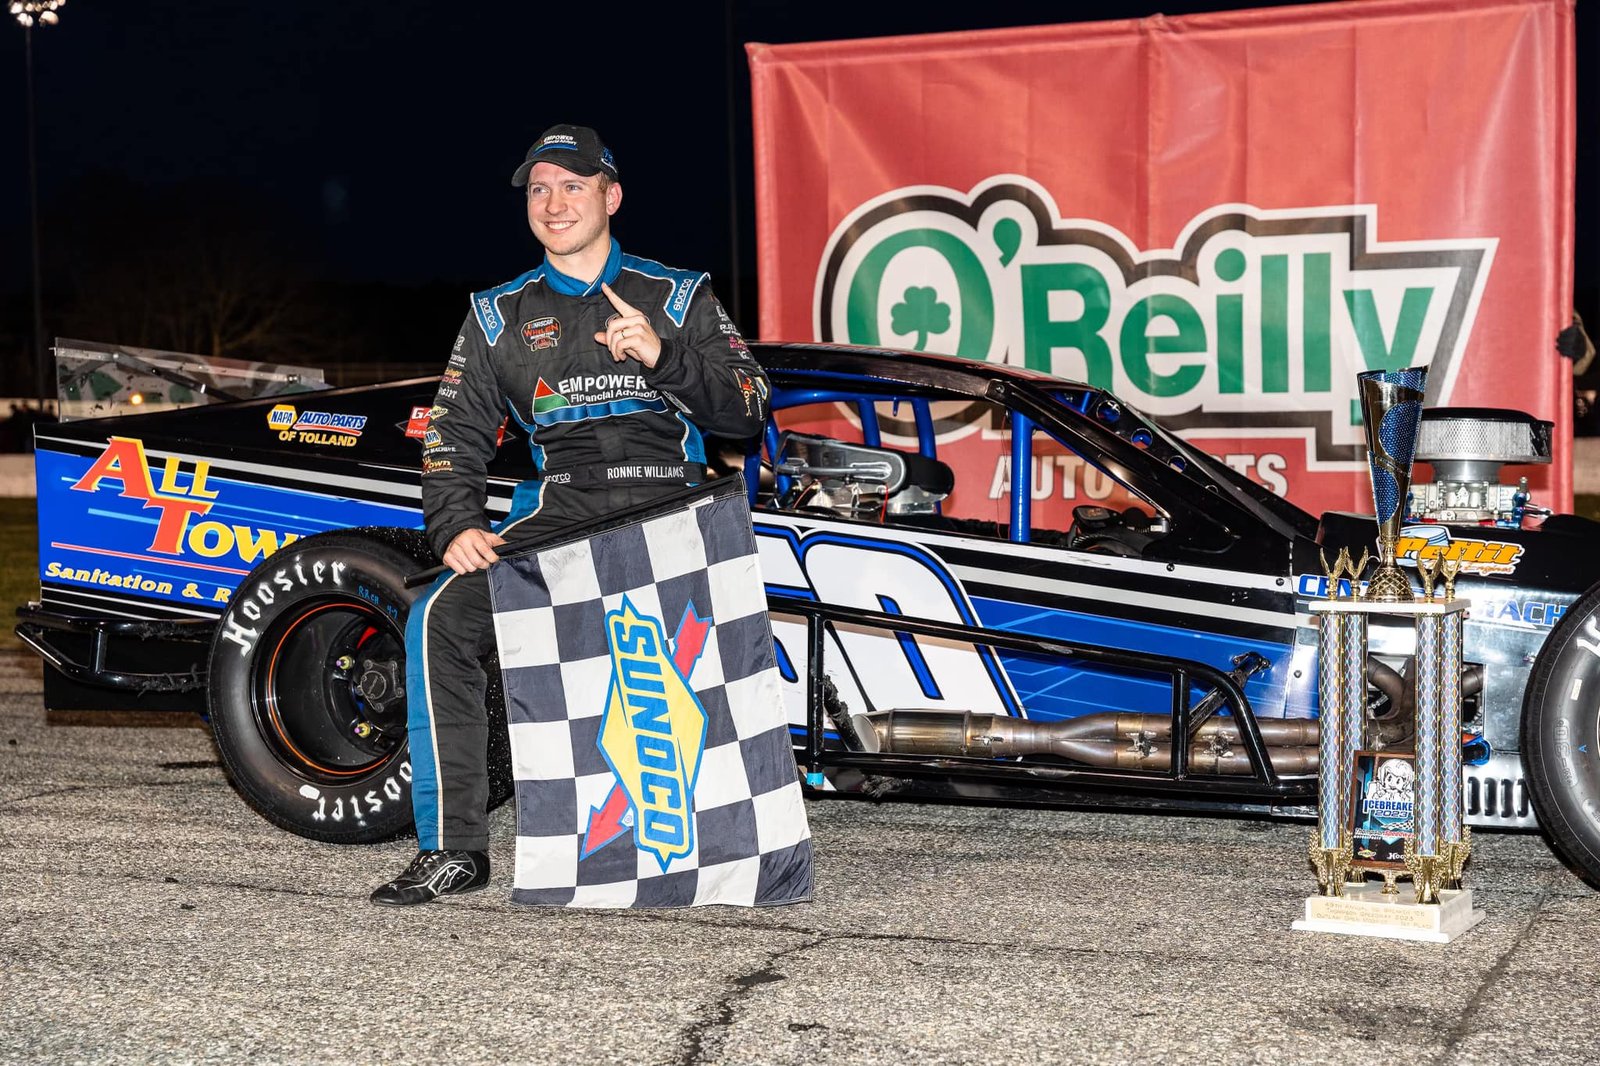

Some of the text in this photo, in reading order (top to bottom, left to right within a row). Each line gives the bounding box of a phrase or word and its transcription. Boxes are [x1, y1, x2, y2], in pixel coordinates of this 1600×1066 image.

[674, 277, 694, 312] sparco
[847, 217, 1434, 427] O'Reilly
[558, 374, 647, 394] EMPOWER
[571, 388, 658, 403] Financial Advisory
[270, 410, 367, 430] NAPA AUTO PARTS
[278, 429, 357, 447] OF TOLLAND
[544, 472, 571, 484] sparco
[607, 465, 684, 480] RONNIE WILLIAMS
[45, 562, 173, 595] Sanitation
[181, 583, 205, 599] &
[222, 554, 347, 657] Hoosier
[613, 619, 686, 847] SUNOCO
[1363, 799, 1413, 815] ICEBREAKE
[1374, 809, 1409, 819] 2023
